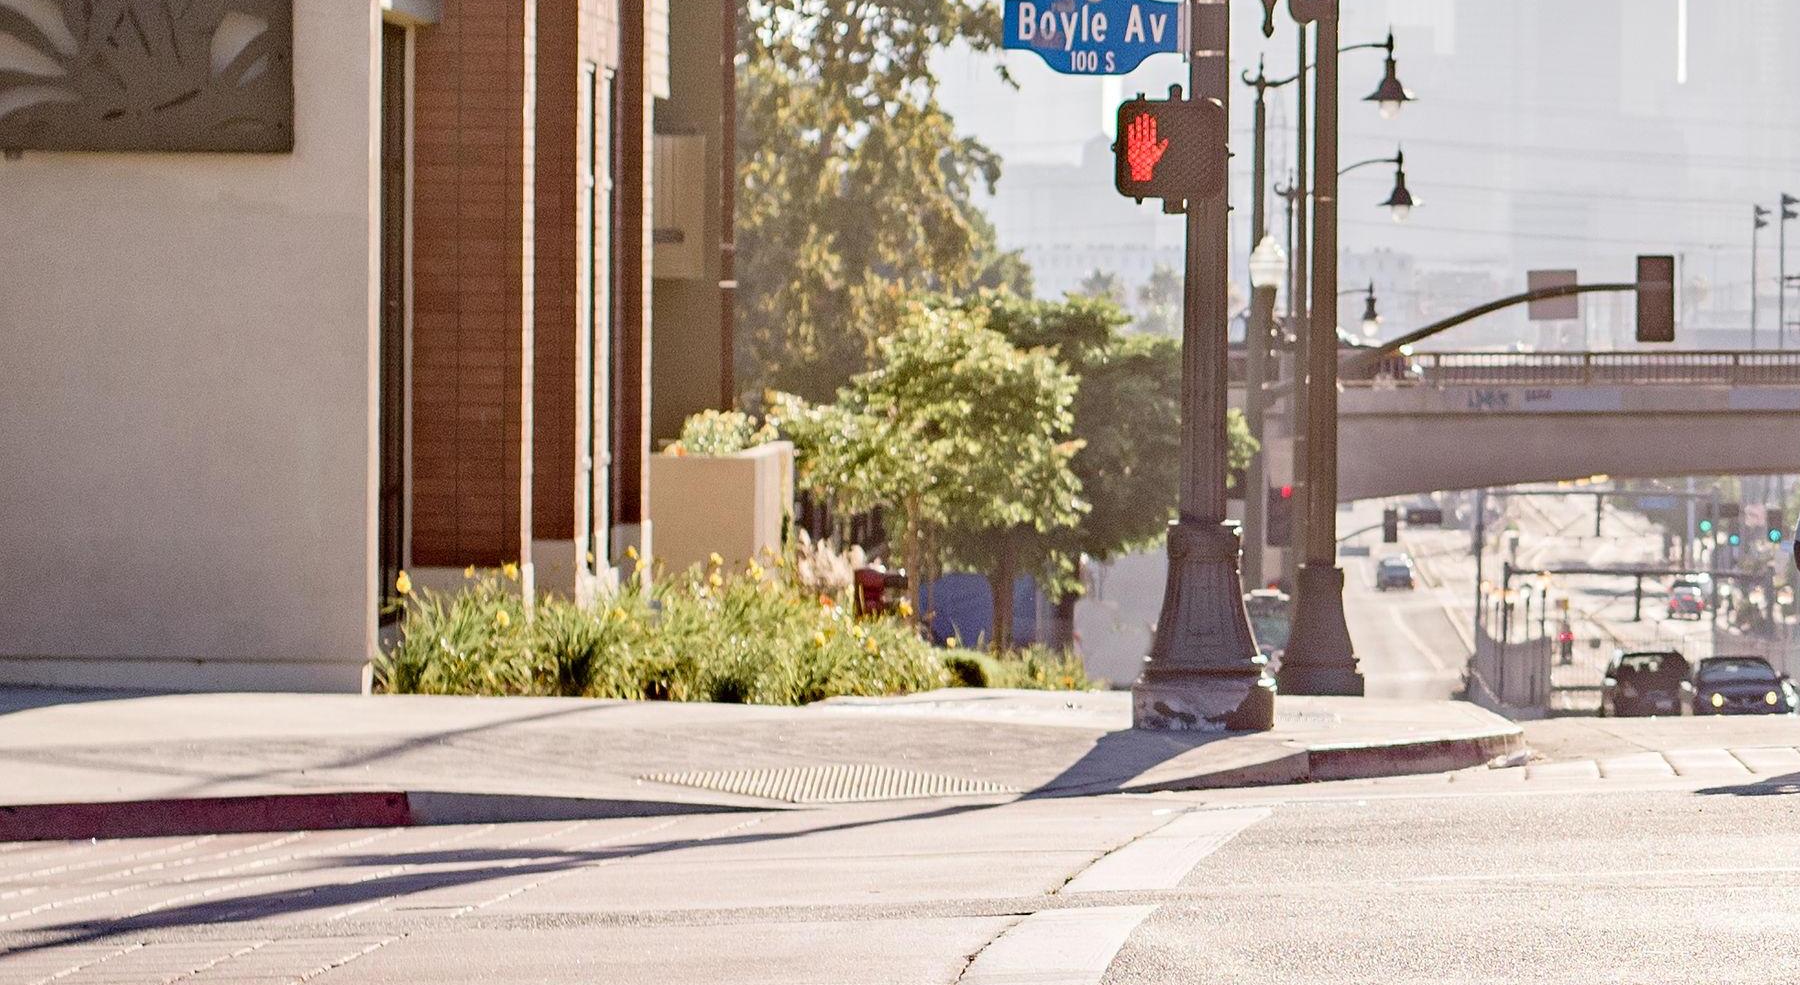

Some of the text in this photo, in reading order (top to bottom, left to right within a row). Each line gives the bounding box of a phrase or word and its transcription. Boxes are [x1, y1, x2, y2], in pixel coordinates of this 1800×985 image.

[1018, 2, 1167, 51] Boyle Av
[1070, 50, 1115, 72] 100 S
